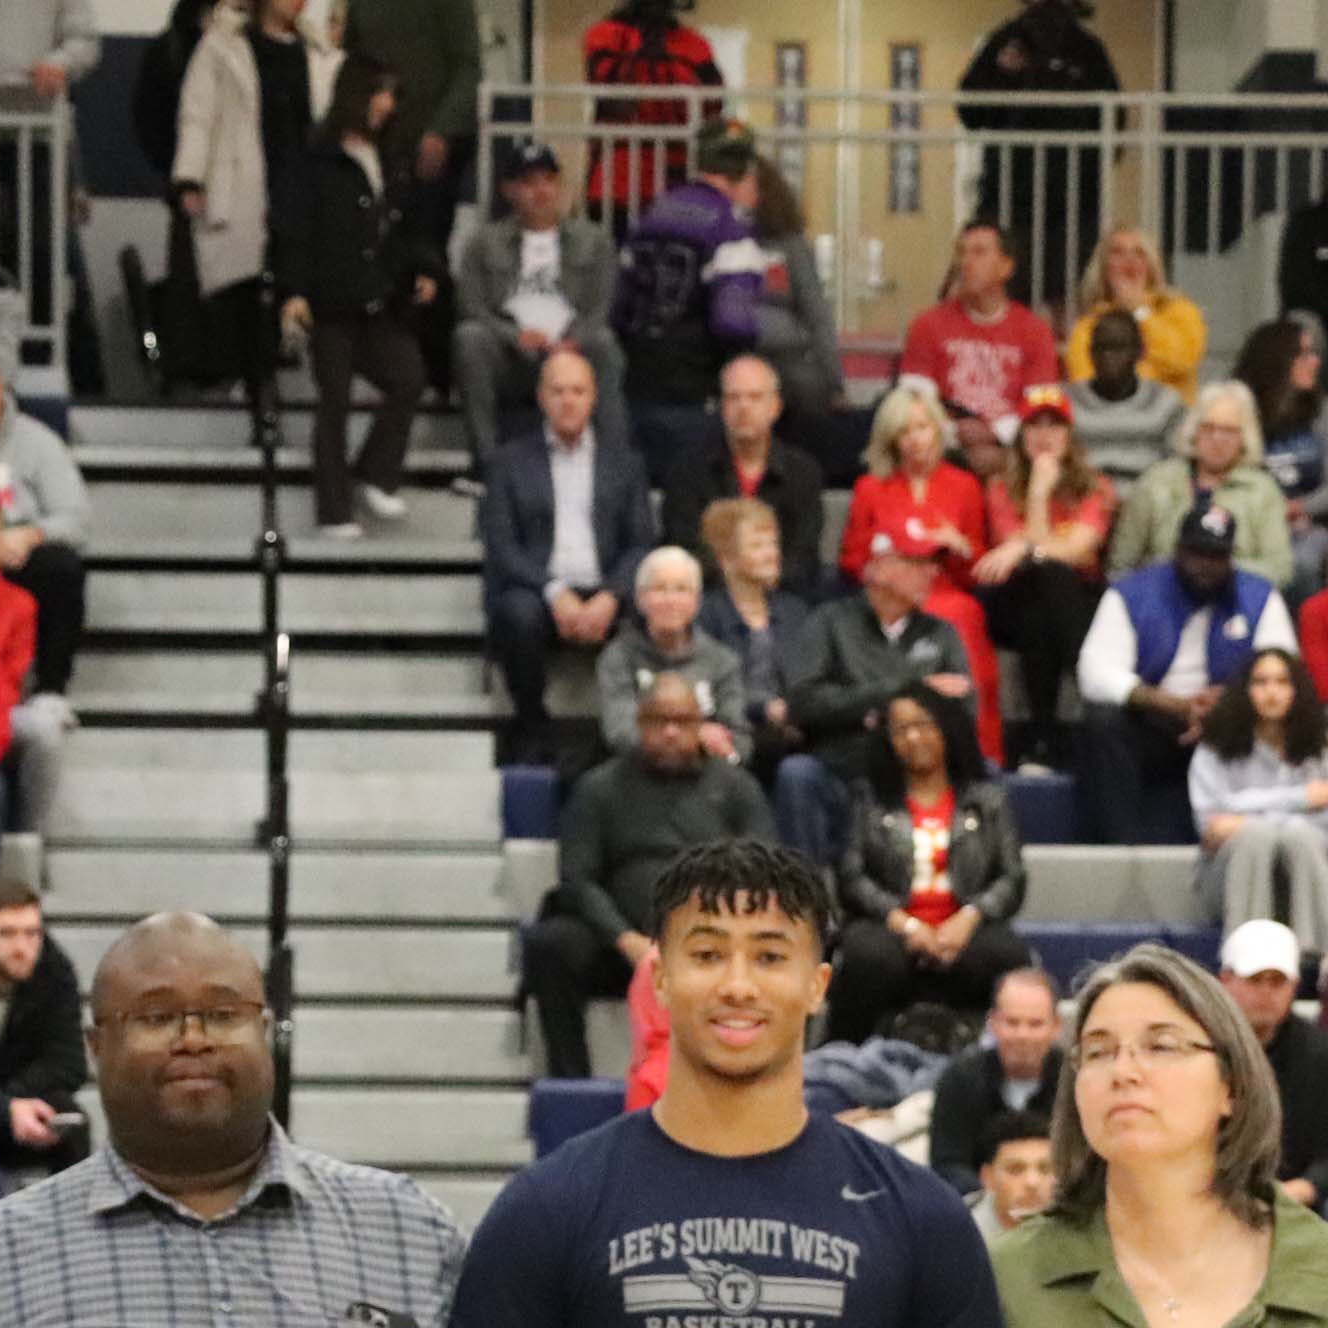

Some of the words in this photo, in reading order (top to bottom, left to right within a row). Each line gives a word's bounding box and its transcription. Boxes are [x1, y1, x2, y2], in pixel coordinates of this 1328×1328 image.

[608, 1222, 676, 1276] LEE'S
[680, 1217, 787, 1258] SUMMIT
[789, 1223, 861, 1279] WEST
